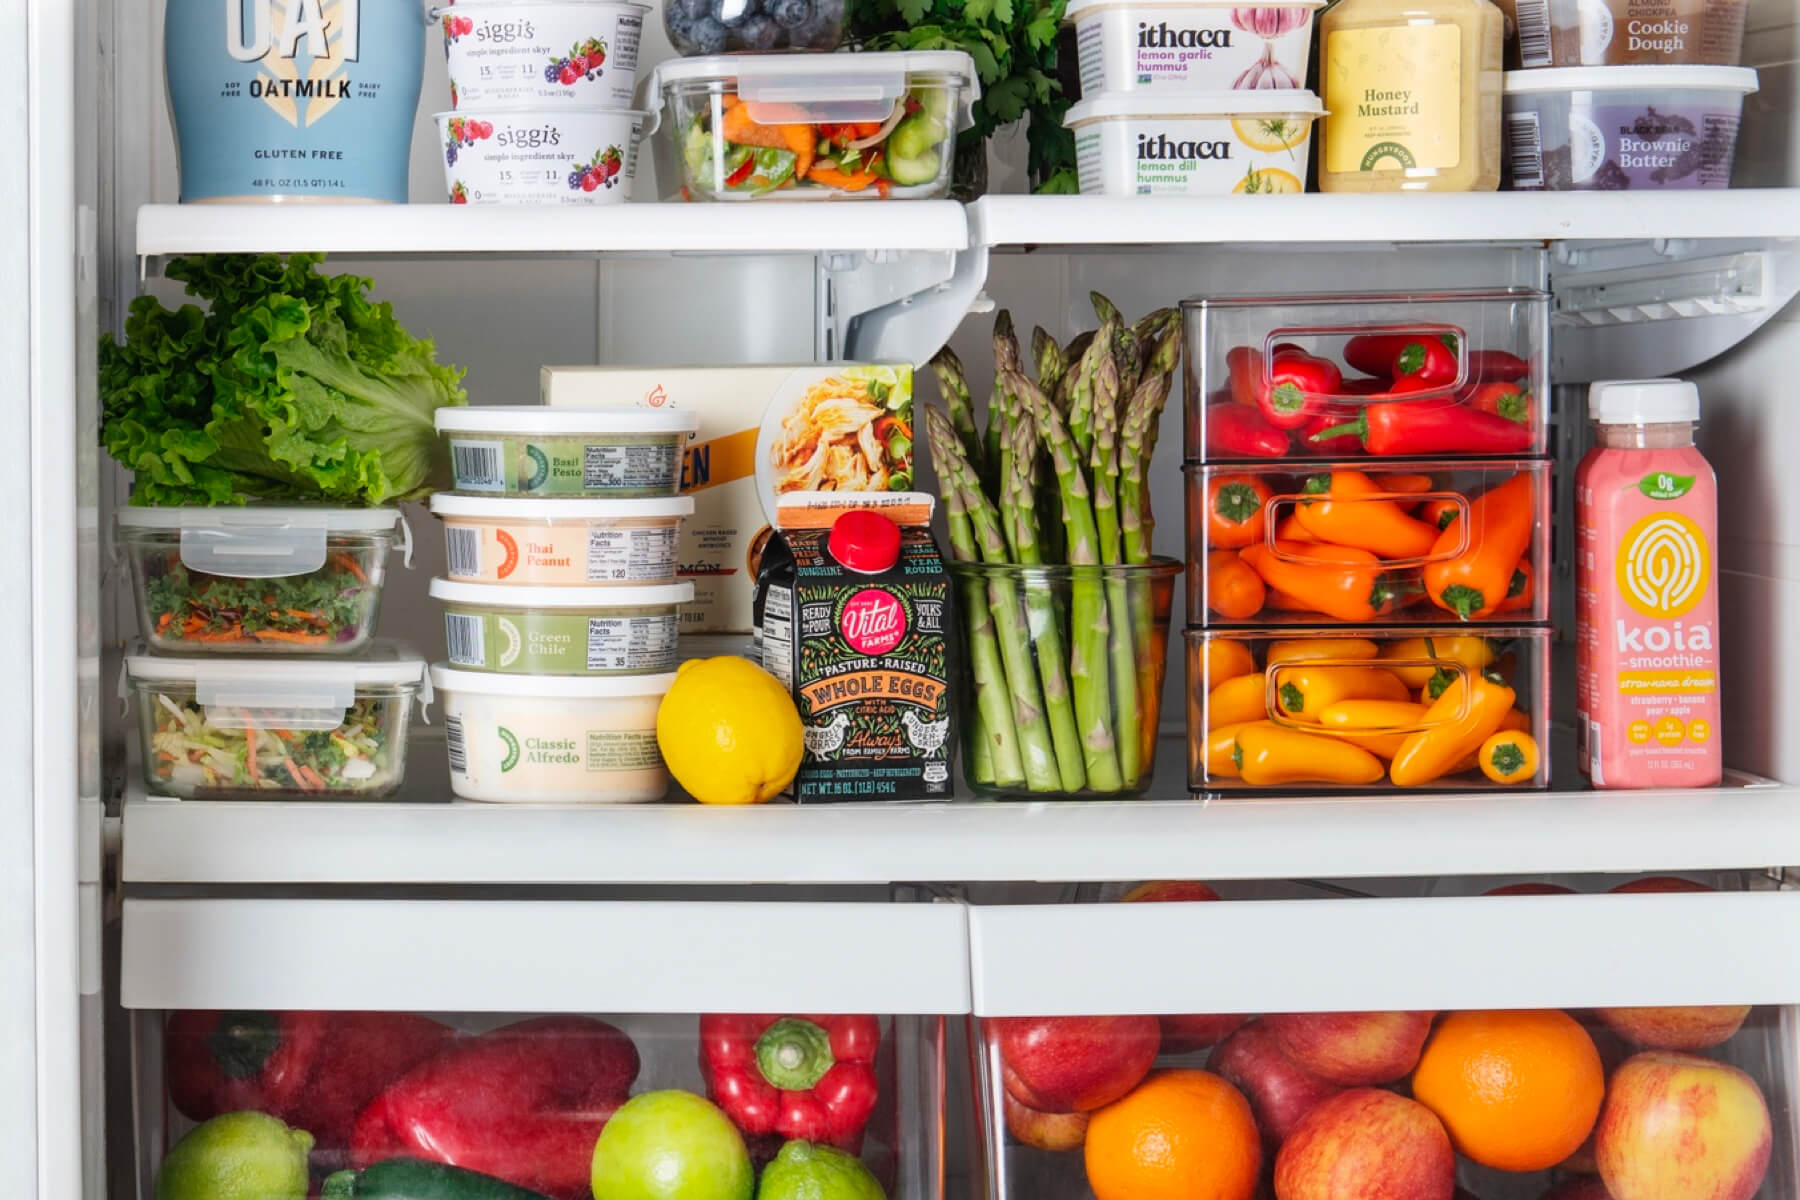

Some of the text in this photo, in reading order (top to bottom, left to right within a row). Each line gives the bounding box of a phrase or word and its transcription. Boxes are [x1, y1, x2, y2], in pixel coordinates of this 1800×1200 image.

[1628, 9, 1677, 17] CHICKPEA
[476, 19, 535, 42] siggi's
[1628, 20, 1689, 35] Cookie
[1136, 22, 1233, 48] ithaca
[1628, 37, 1684, 53] Dough
[467, 46, 551, 58] simple ingredient skyr
[1137, 50, 1213, 62] lemon garlic
[1137, 62, 1187, 72] hummus
[250, 80, 351, 98] OATMILK
[1365, 89, 1412, 103] Honey
[1358, 103, 1419, 117] Mustard
[497, 125, 560, 148] siggi's
[1620, 126, 1680, 135] BLACK BEAN
[1136, 134, 1233, 160] ithaca
[1620, 138, 1690, 152] Brownie
[254, 150, 343, 160] GLUTEN FREE
[484, 152, 576, 163] simple ingredient skyr
[1620, 154, 1676, 168] Batter
[1137, 161, 1197, 171] lemon dill
[311, 180, 326, 188] QT)
[1137, 173, 1187, 183] hummus
[553, 457, 579, 467] Basil
[553, 468, 582, 477] Pesto
[1658, 474, 1673, 491] 0g
[591, 531, 623, 540] Nutrition
[526, 543, 554, 554] Thai
[526, 557, 571, 567] Peanut
[612, 569, 626, 578] 120
[797, 566, 843, 576] SUNSHINE
[904, 566, 943, 575] ROUND
[803, 607, 831, 621] READY
[916, 604, 942, 617] YOLKS
[590, 620, 623, 628] Nutrition
[844, 599, 898, 638] Vital
[925, 618, 941, 629] ALL
[810, 619, 831, 633] POUR
[528, 632, 571, 643] Green
[1616, 620, 1712, 653] koia
[528, 644, 566, 655] Chile
[615, 658, 625, 667] 35
[1629, 654, 1704, 668] smoothie
[813, 676, 936, 704] WHOLE EGGS
[525, 738, 577, 750] Classic
[810, 736, 841, 747] GRASS
[846, 729, 904, 758] Always
[525, 751, 580, 763] Alfredo
[843, 747, 861, 756] FROM
[802, 783, 817, 795] NET
